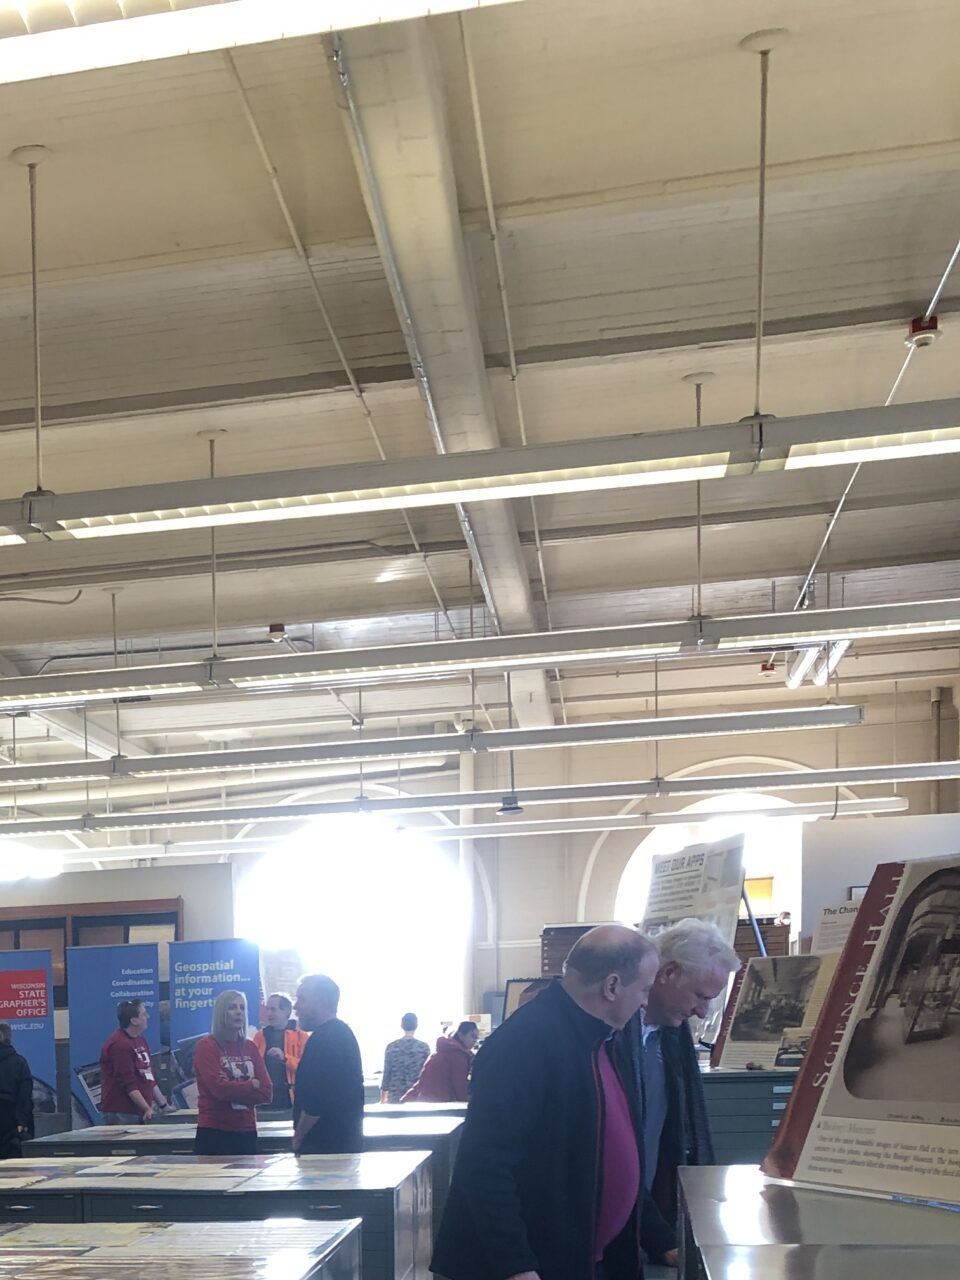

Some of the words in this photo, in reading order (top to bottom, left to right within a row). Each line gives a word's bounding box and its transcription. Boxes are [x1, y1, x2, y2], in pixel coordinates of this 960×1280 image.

[687, 853, 705, 866] APPS
[823, 907, 838, 915] The
[174, 960, 234, 973] Geospatial
[111, 979, 154, 987] Coordination
[18, 990, 46, 998] STATE
[110, 990, 154, 998] Collaboration
[175, 988, 186, 996] at
[187, 988, 213, 998] your
[16, 1008, 47, 1017] OFFICE
